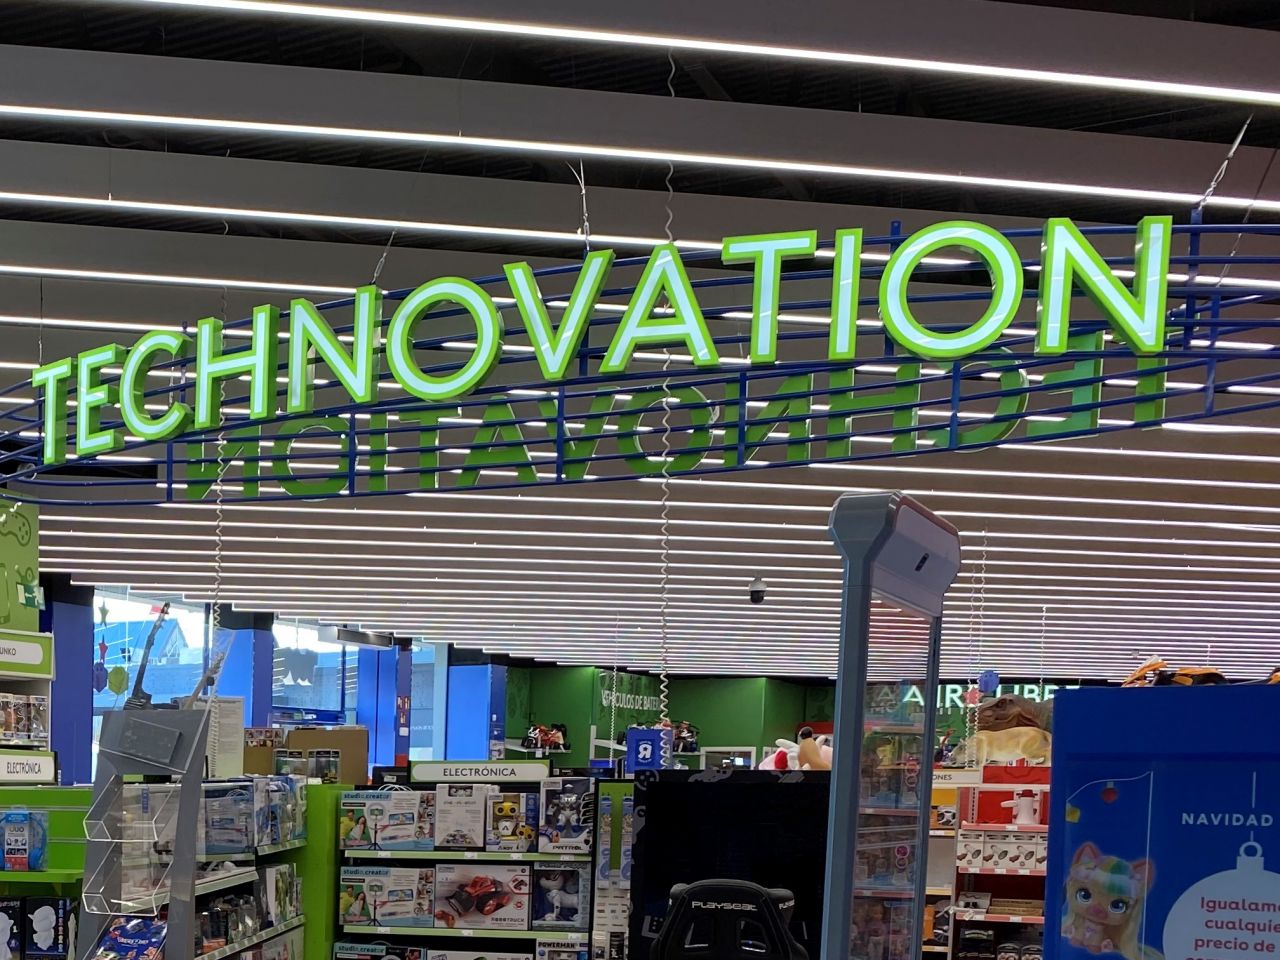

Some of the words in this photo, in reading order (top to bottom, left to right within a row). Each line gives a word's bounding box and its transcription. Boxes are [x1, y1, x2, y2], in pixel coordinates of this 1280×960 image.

[31, 214, 1174, 466] TECHNOVATION
[6, 760, 42, 776] ELECTRÓNICA
[442, 766, 518, 778] ELECTRÓNICA
[1180, 812, 1274, 827] NAVIDAD
[537, 941, 576, 949] POWERMAN
[1193, 937, 1249, 952] precio
[1253, 939, 1276, 953] de
